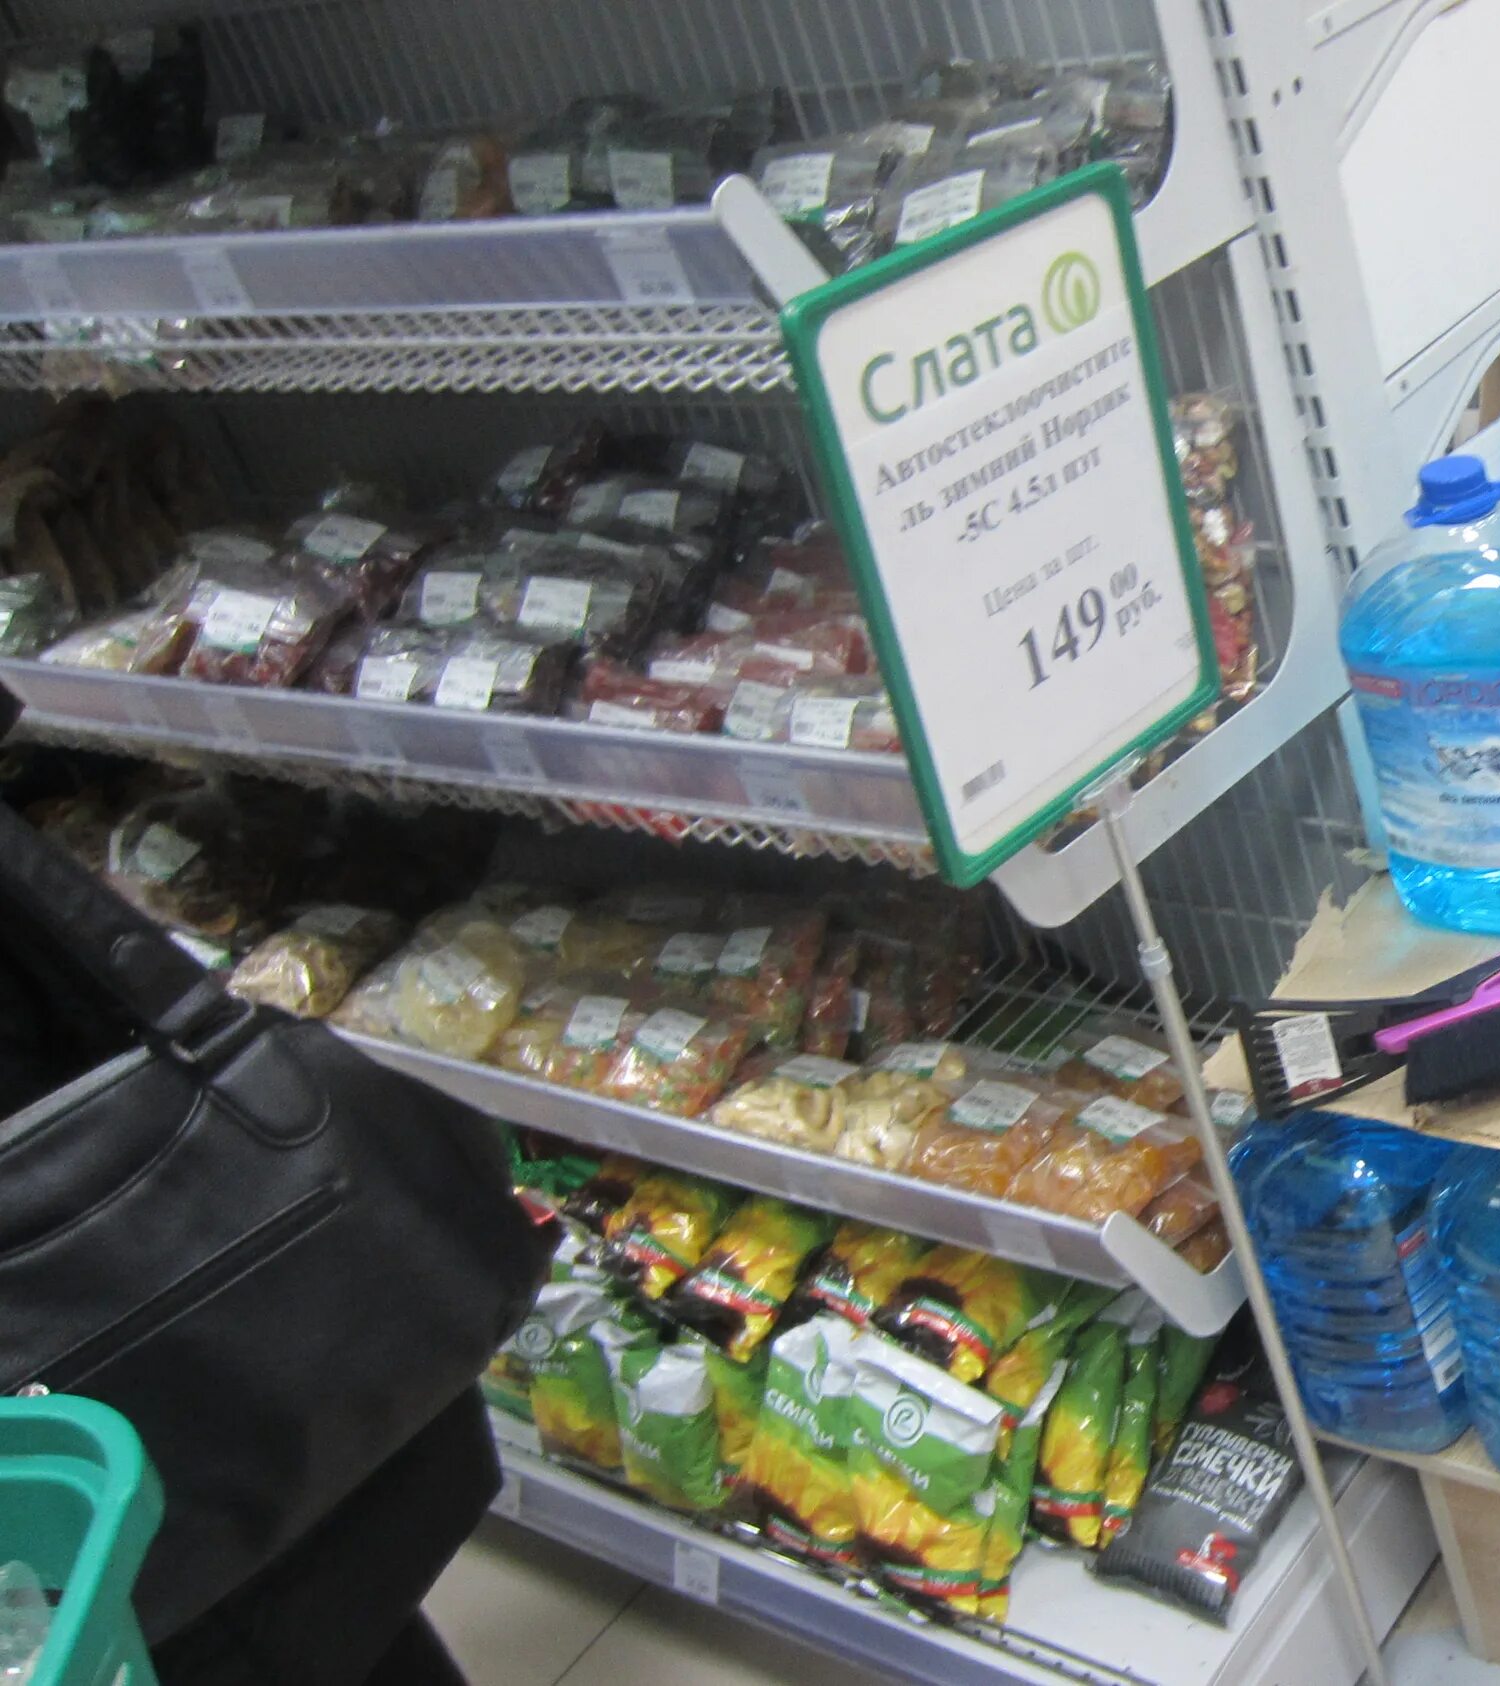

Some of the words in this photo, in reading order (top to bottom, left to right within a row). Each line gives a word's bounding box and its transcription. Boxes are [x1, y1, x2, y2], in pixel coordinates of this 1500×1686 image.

[860, 302, 1039, 425] Слата
[875, 335, 1133, 496] Автостеклоочистите
[900, 500, 935, 533] ль
[938, 432, 1037, 509] зимний
[1040, 381, 1132, 449] Нордик
[1008, 474, 1058, 514] 4.5л
[1062, 446, 1102, 484] пэт
[983, 572, 1037, 617] Цена
[1040, 556, 1063, 580] за
[1065, 535, 1100, 566] шт.
[1017, 586, 1107, 690] 149
[1109, 563, 1138, 599] 00
[1115, 580, 1162, 637] руб.
[1171, 1440, 1283, 1501] СЕМЕЧКИ
